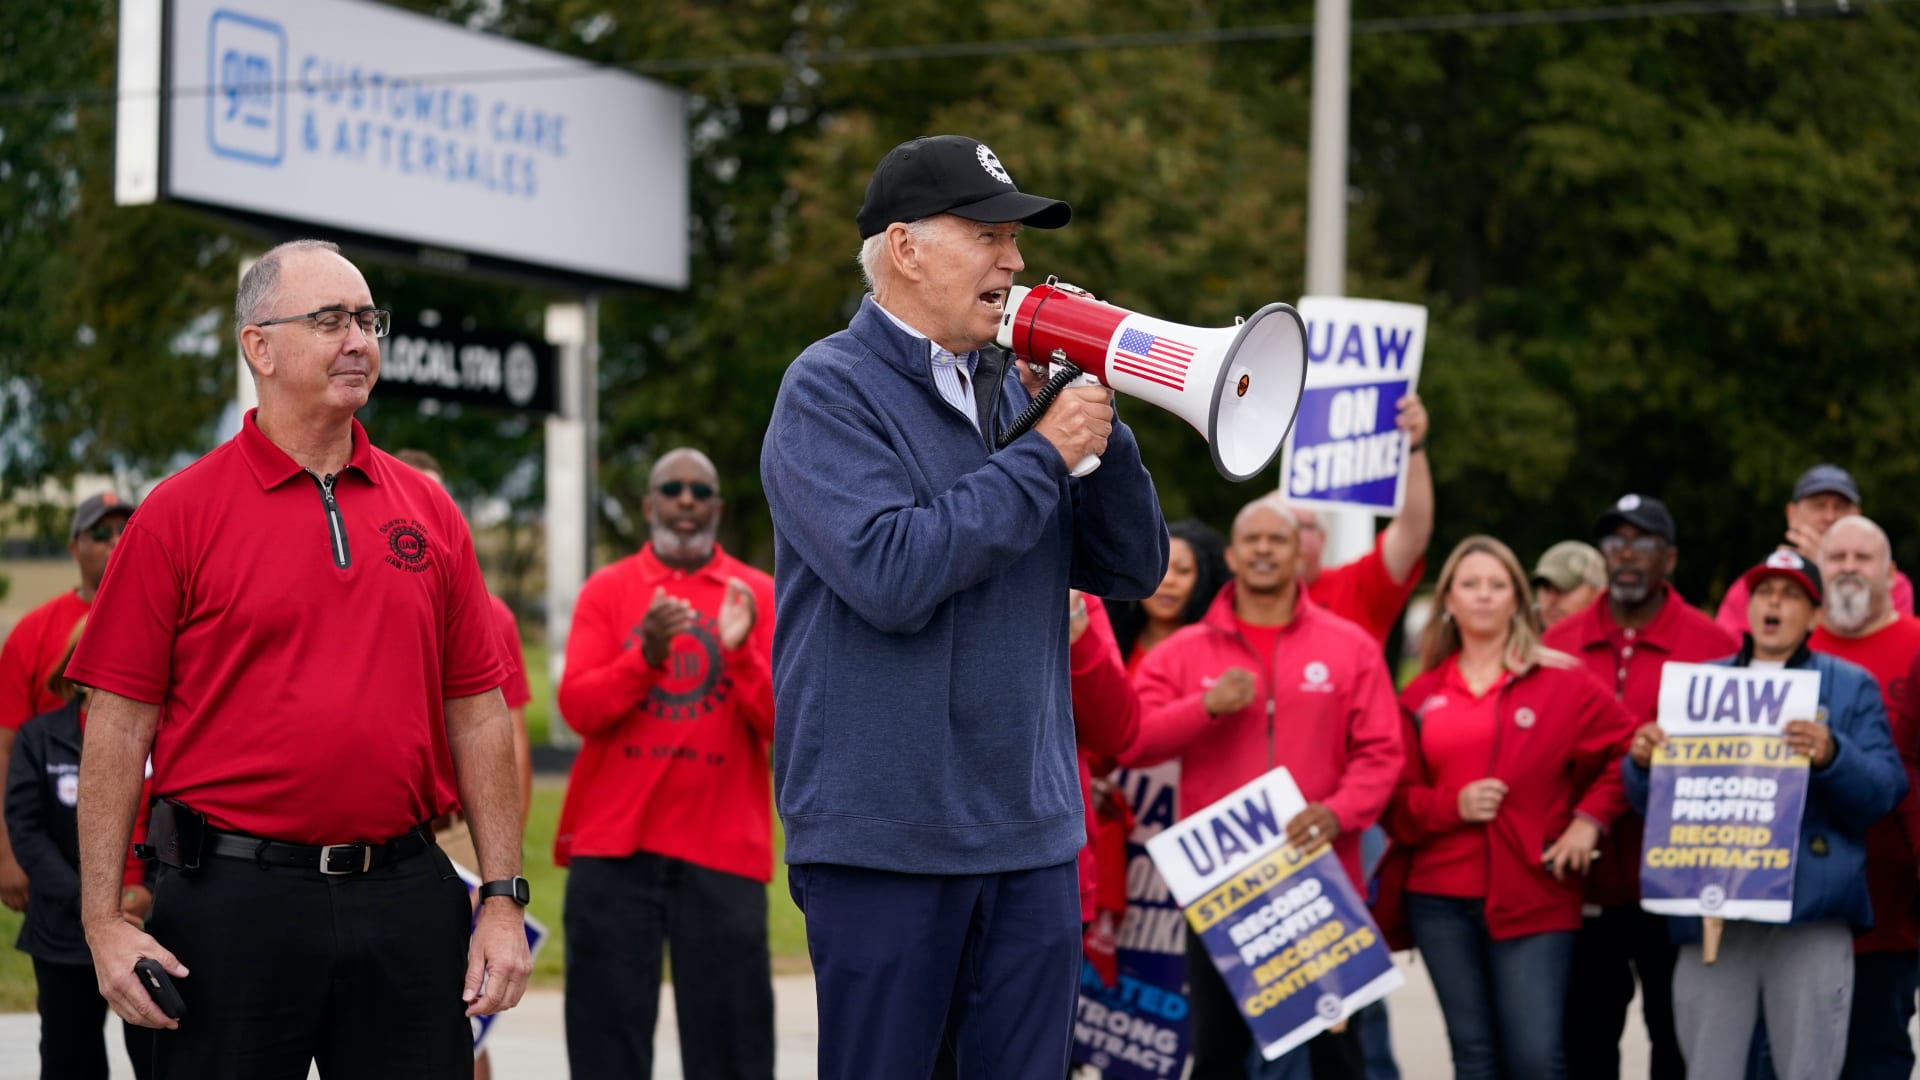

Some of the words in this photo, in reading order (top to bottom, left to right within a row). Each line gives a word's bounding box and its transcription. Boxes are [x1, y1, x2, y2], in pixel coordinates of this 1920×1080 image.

[302, 55, 477, 131] CUSTOMER
[491, 99, 567, 158] CARE
[302, 110, 318, 152] &
[333, 118, 538, 198] AFTERSALES
[380, 334, 460, 389] LOCAL
[1308, 321, 1412, 370] UAW
[1328, 386, 1379, 439] ON
[1292, 430, 1401, 497] STRIKE
[1687, 676, 1792, 726] UAW
[1665, 742, 1753, 760] STAND
[1672, 799, 1776, 823] PROFITS
[1675, 776, 1778, 800] RECORD
[1178, 789, 1280, 877] UAW
[1646, 846, 1790, 871] CONTRACTS
[1669, 825, 1772, 847] RECORD
[1198, 863, 1279, 922] STAND
[1228, 877, 1323, 947] RECORD
[1239, 895, 1335, 967] PROFITS
[1253, 920, 1345, 987] RECORD
[1245, 926, 1376, 1018] CONTRACTS
[1074, 1022, 1176, 1075] NTRACT
[1078, 994, 1178, 1056] TRONG
